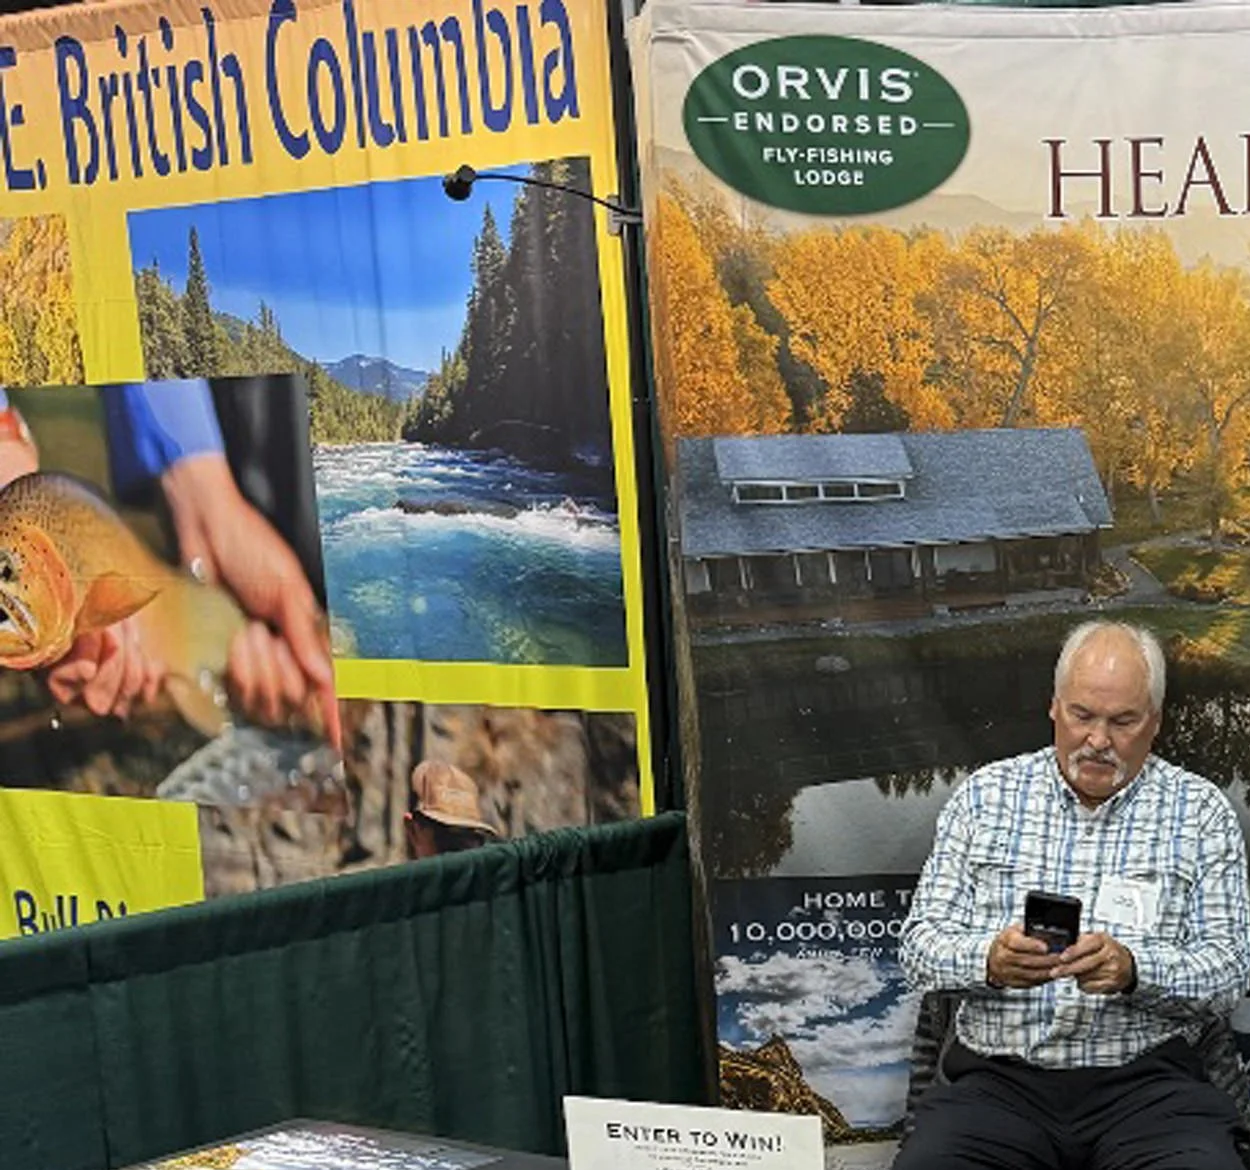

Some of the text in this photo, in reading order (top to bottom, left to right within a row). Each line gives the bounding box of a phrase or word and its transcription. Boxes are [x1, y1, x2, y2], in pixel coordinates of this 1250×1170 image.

[54, 8, 253, 186] British
[266, 0, 581, 160] Columbia
[731, 64, 914, 103] ORVIS
[733, 112, 918, 136] ENDORSED
[762, 147, 894, 166] FLY-FISHING
[794, 169, 865, 186] LODGE
[803, 891, 885, 909] HOME
[606, 1122, 783, 1152] ENTER TO WIN!
